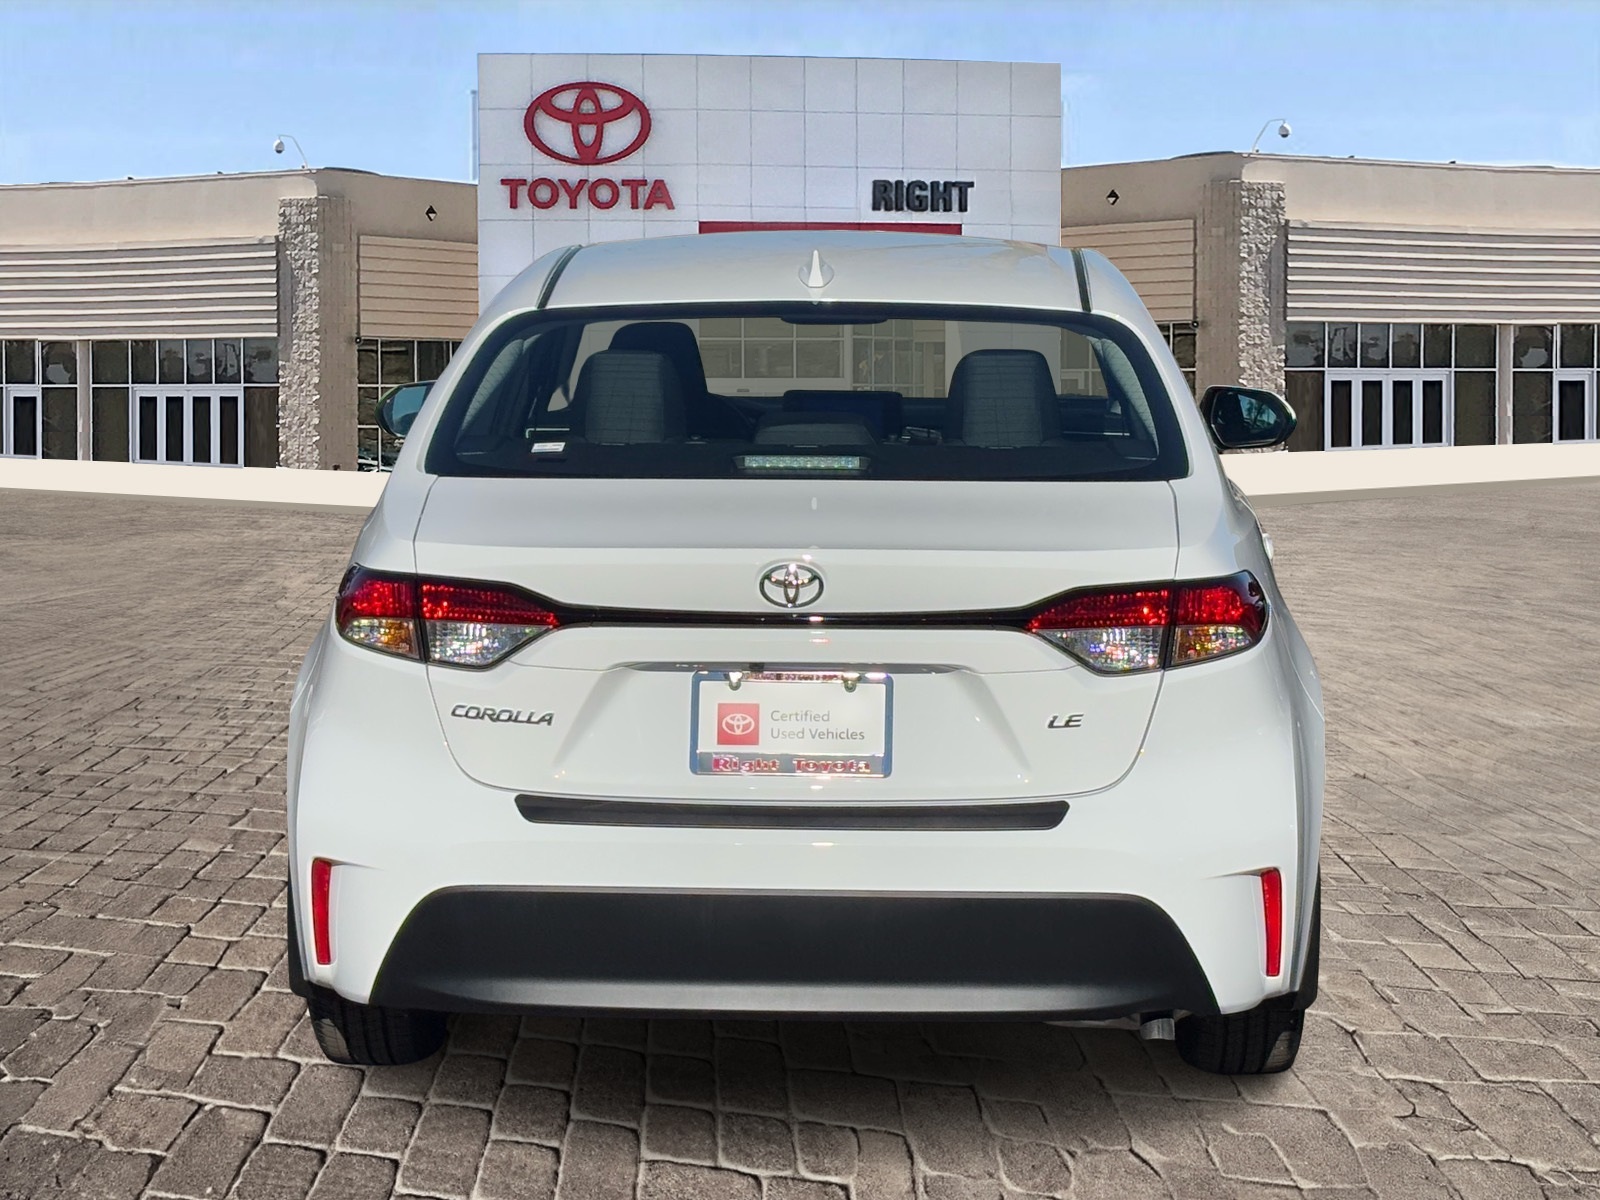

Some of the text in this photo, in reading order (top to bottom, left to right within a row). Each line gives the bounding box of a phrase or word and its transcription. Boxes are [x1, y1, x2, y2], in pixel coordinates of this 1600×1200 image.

[500, 178, 675, 209] TOYOTA
[872, 180, 975, 212] RIGHT
[451, 704, 554, 726] COROLLA
[770, 710, 830, 722] Certified
[1047, 714, 1084, 729] LE
[770, 728, 865, 740] Used Vehicles
[712, 756, 871, 774] Right Toyota
